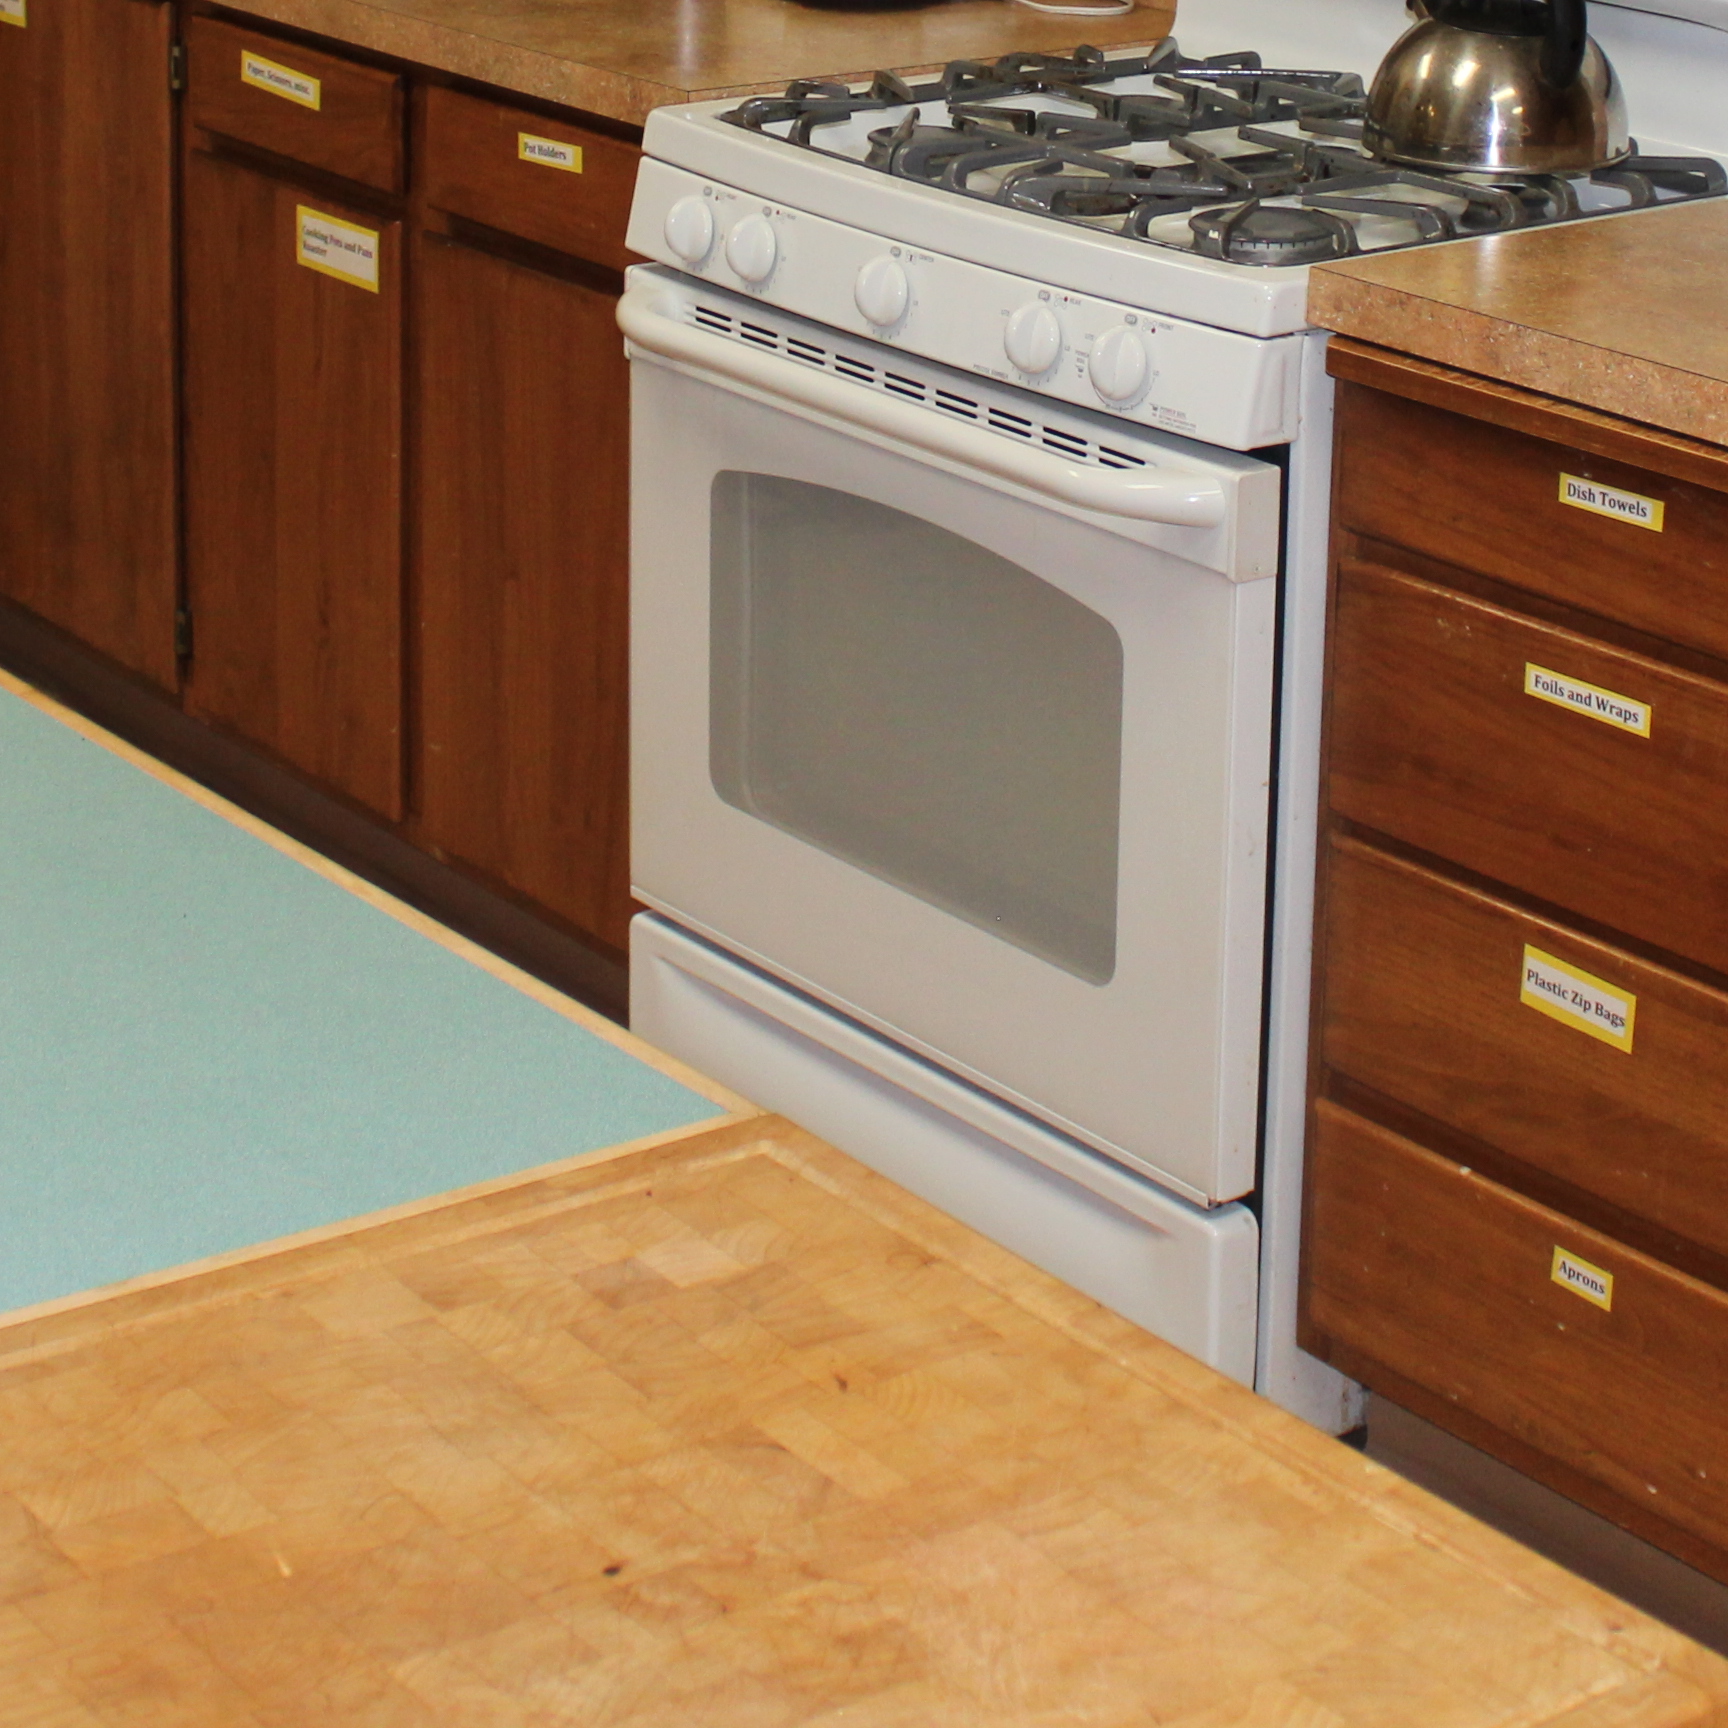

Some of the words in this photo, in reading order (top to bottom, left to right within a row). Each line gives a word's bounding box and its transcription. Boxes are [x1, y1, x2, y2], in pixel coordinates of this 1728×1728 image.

[524, 142, 537, 154] Pot
[538, 145, 567, 160] Holders
[344, 242, 357, 253] and
[1567, 482, 1596, 504] Dish
[1599, 491, 1648, 518] Towels
[1534, 674, 1565, 697] Foils
[1567, 690, 1592, 707] and
[1595, 696, 1639, 724] Wraps
[1527, 968, 1570, 1000] Plastic
[1571, 990, 1592, 1013] Zip
[1594, 1001, 1626, 1028] Bags
[1559, 1260, 1606, 1294] Aprons
